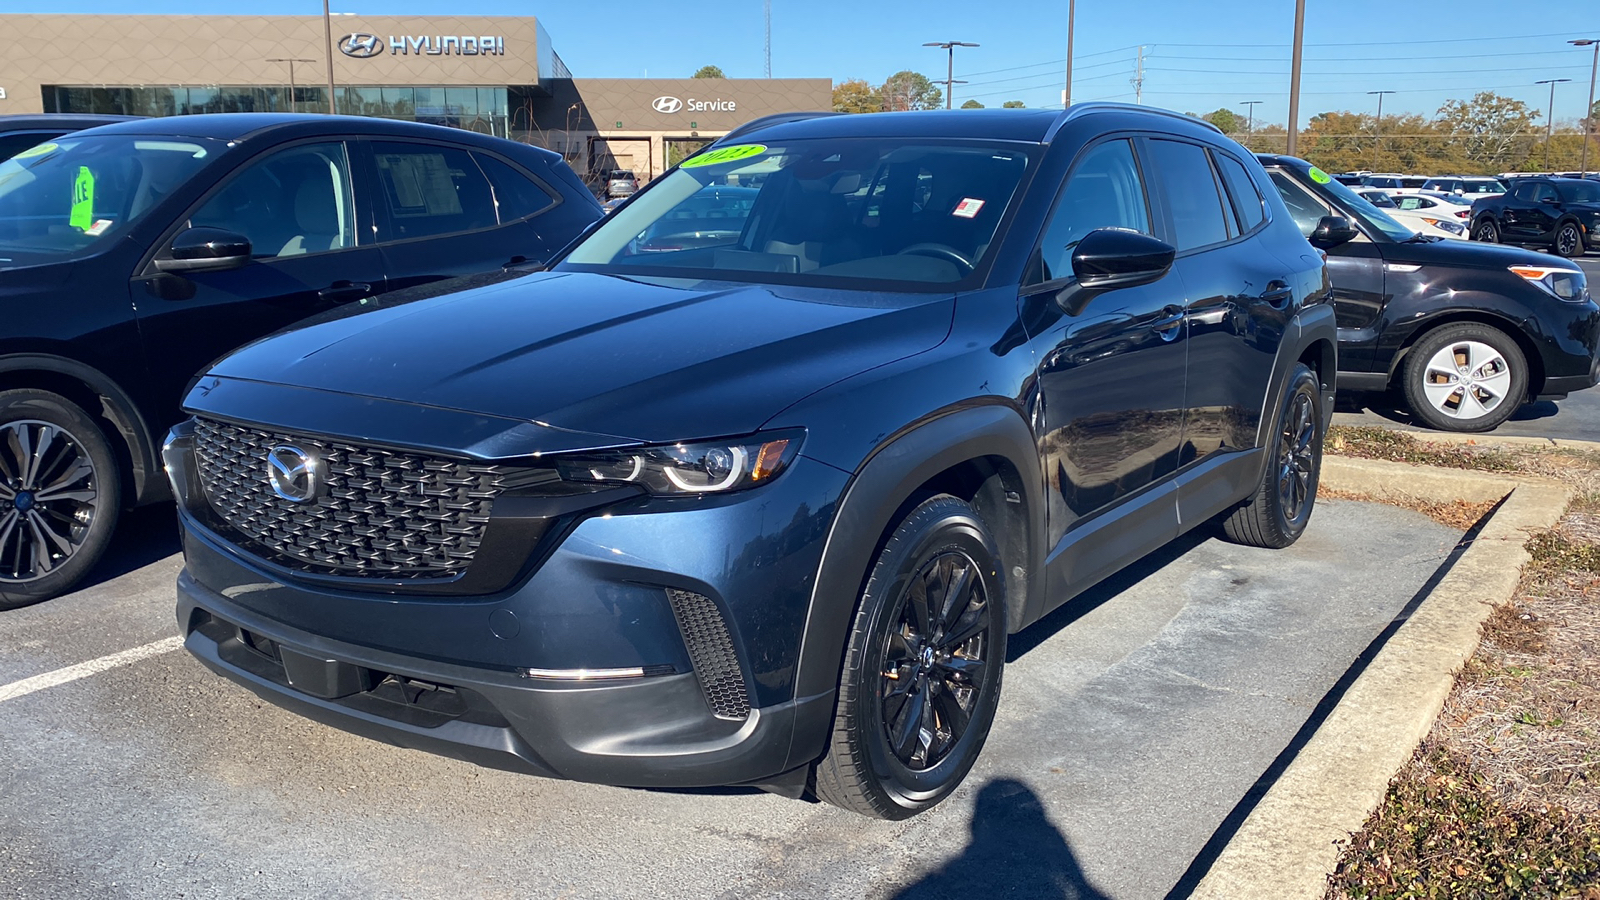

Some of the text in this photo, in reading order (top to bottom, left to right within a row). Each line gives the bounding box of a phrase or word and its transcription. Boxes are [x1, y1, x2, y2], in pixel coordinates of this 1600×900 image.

[389, 35, 504, 55] HYUNDAI
[687, 98, 736, 112] Service
[689, 146, 757, 165] 2023
